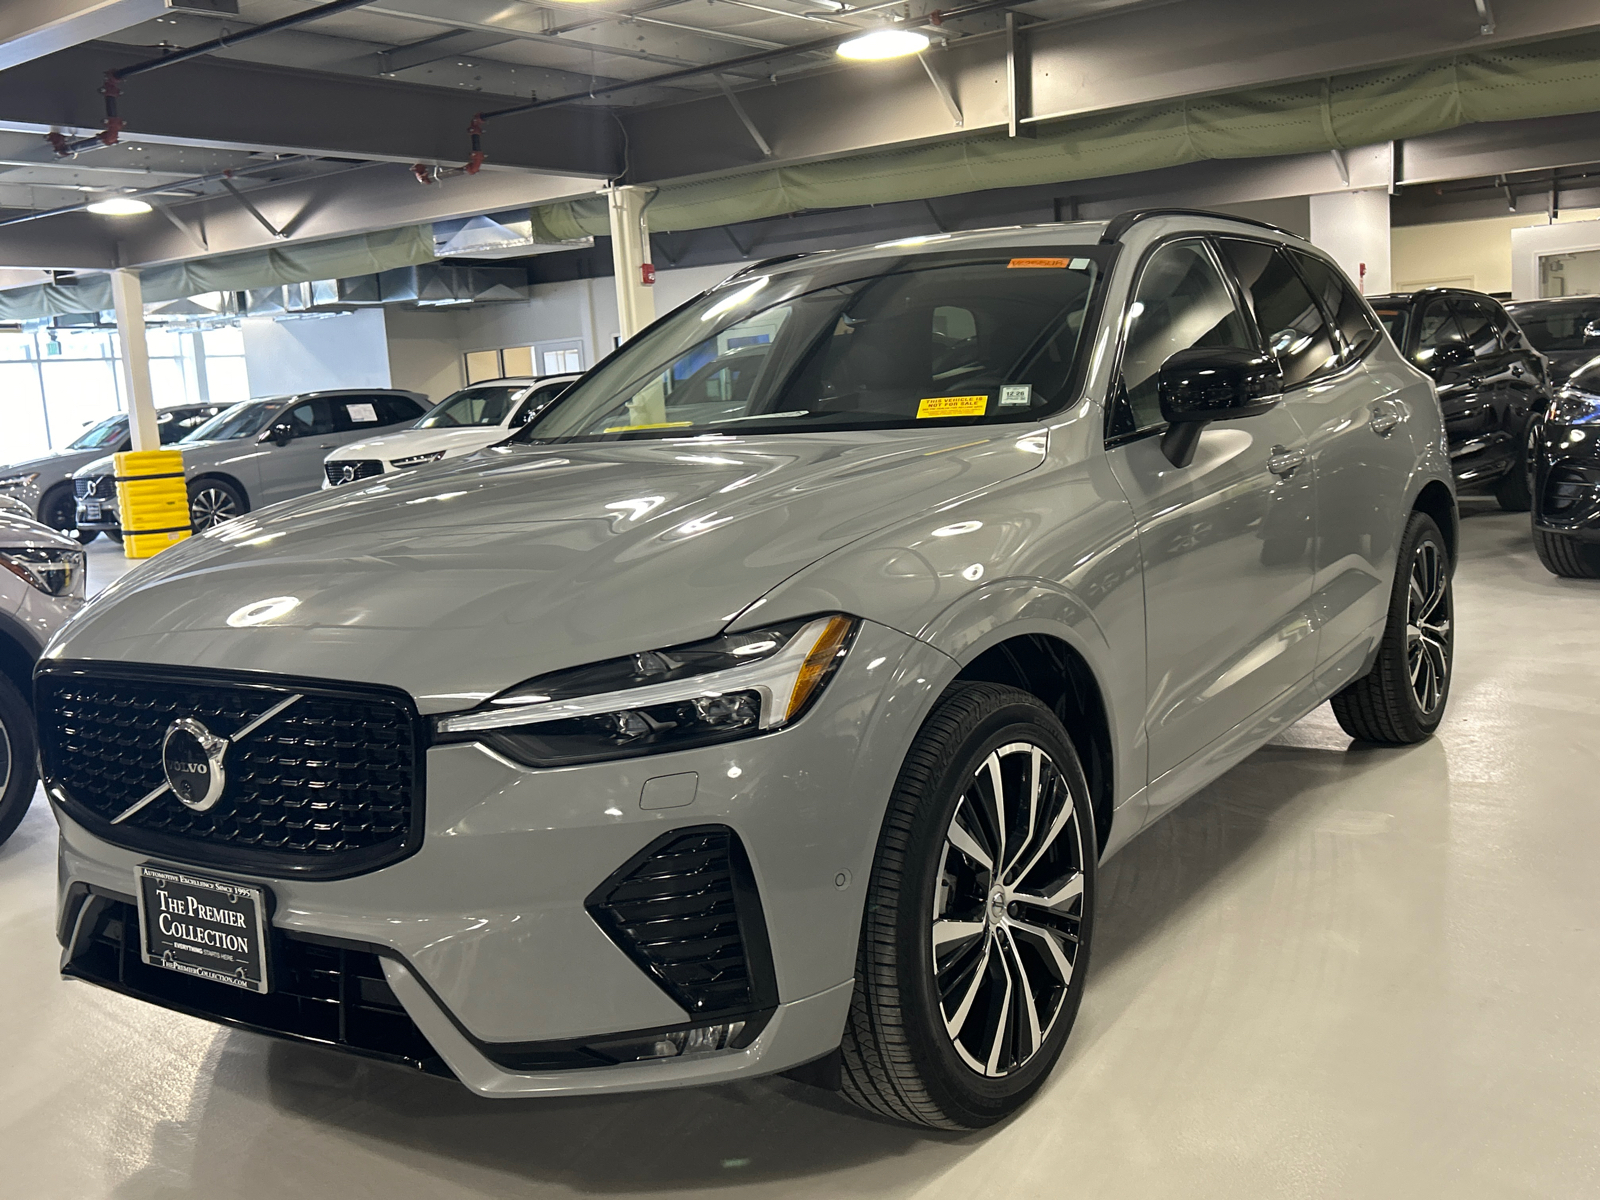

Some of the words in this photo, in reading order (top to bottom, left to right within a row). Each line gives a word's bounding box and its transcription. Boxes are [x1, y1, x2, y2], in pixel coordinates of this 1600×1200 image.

[168, 761, 208, 774] VOLVO
[234, 887, 251, 897] 1995
[156, 889, 186, 916] THE
[186, 895, 246, 928] PREMIER
[159, 912, 249, 954] COLLECTION
